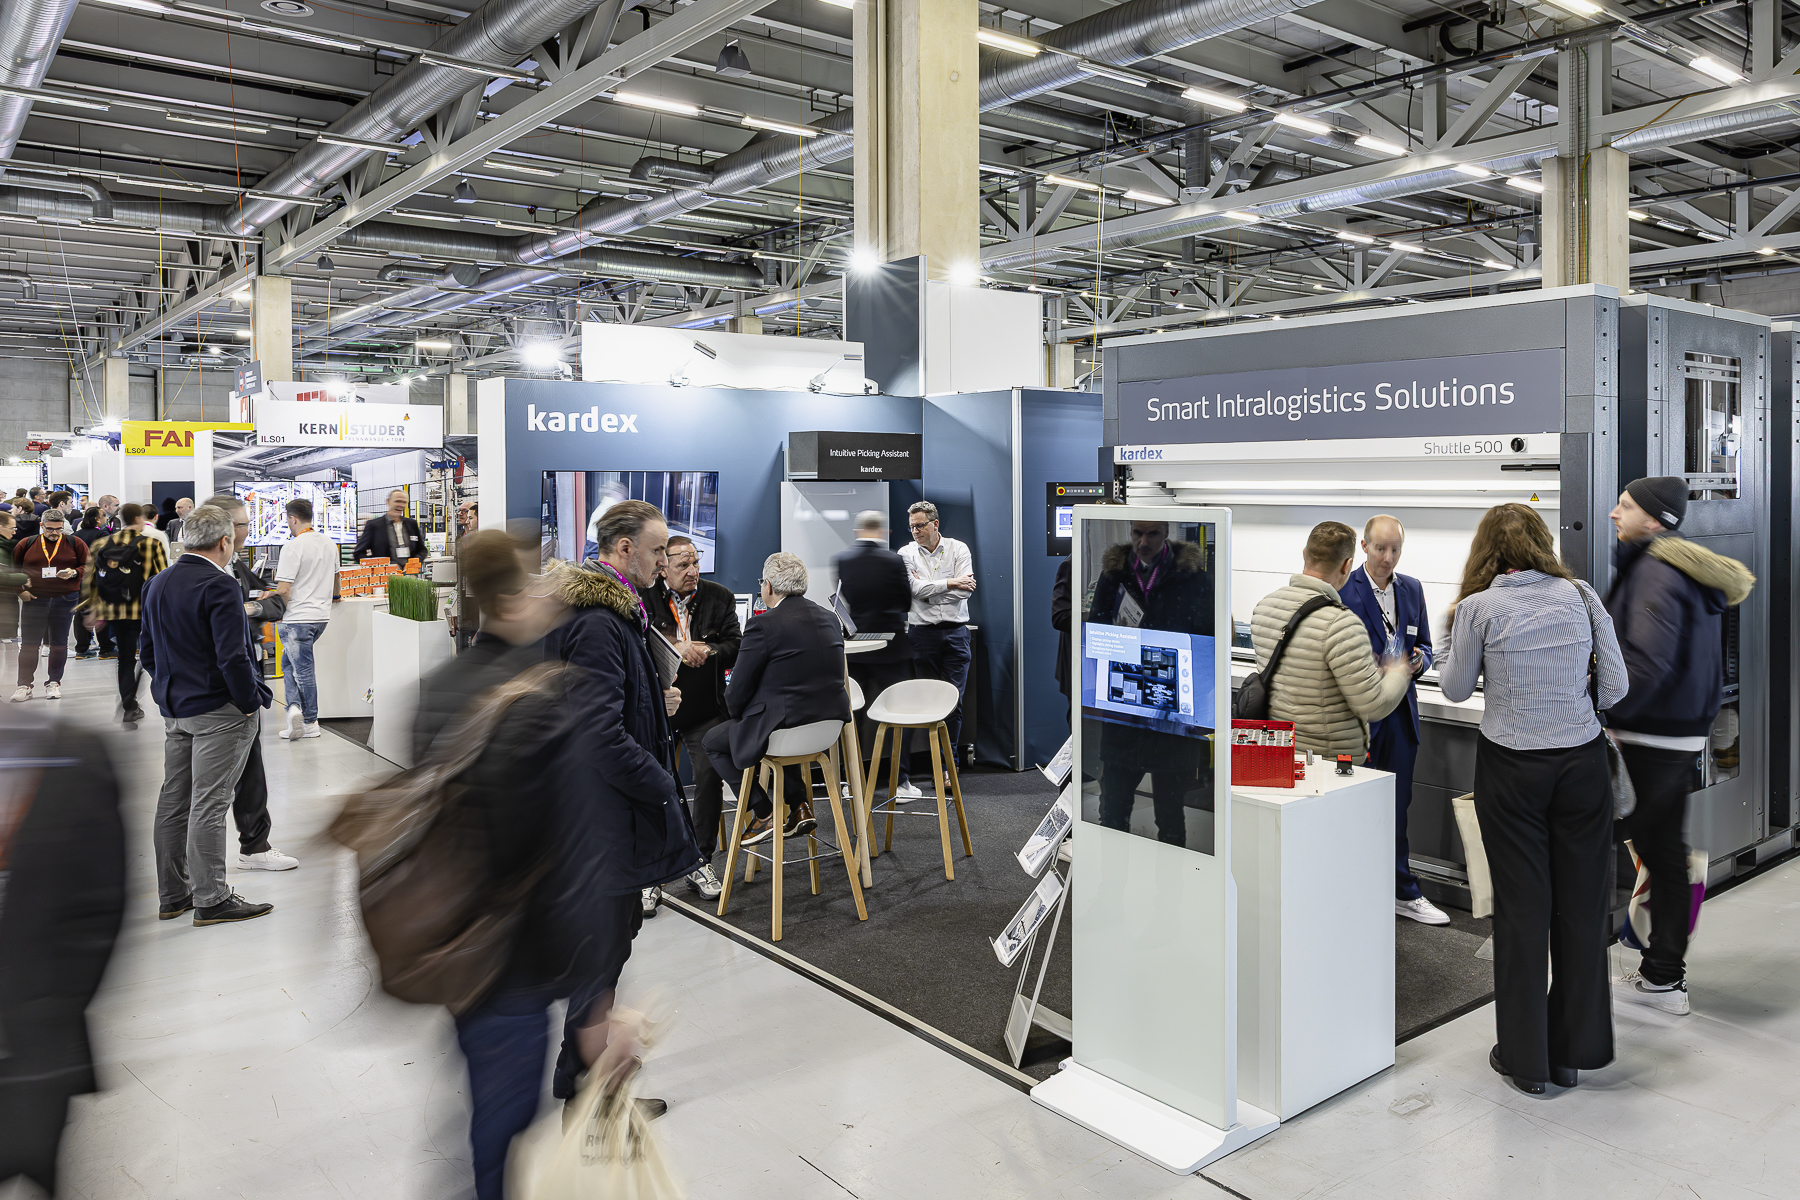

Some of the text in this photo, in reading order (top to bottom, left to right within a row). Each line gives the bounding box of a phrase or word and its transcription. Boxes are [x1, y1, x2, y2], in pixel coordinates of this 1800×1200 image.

[1147, 377, 1516, 422] Smart Intralogistics Solutions
[527, 403, 639, 433] kardex
[299, 423, 405, 436] KERN STUDER
[261, 435, 285, 443] ILS01
[829, 448, 910, 459] Intuitive Picking Assistant
[1120, 446, 1163, 460] kardex
[1424, 440, 1503, 455] Shuttle 500
[860, 465, 882, 473] kardex
